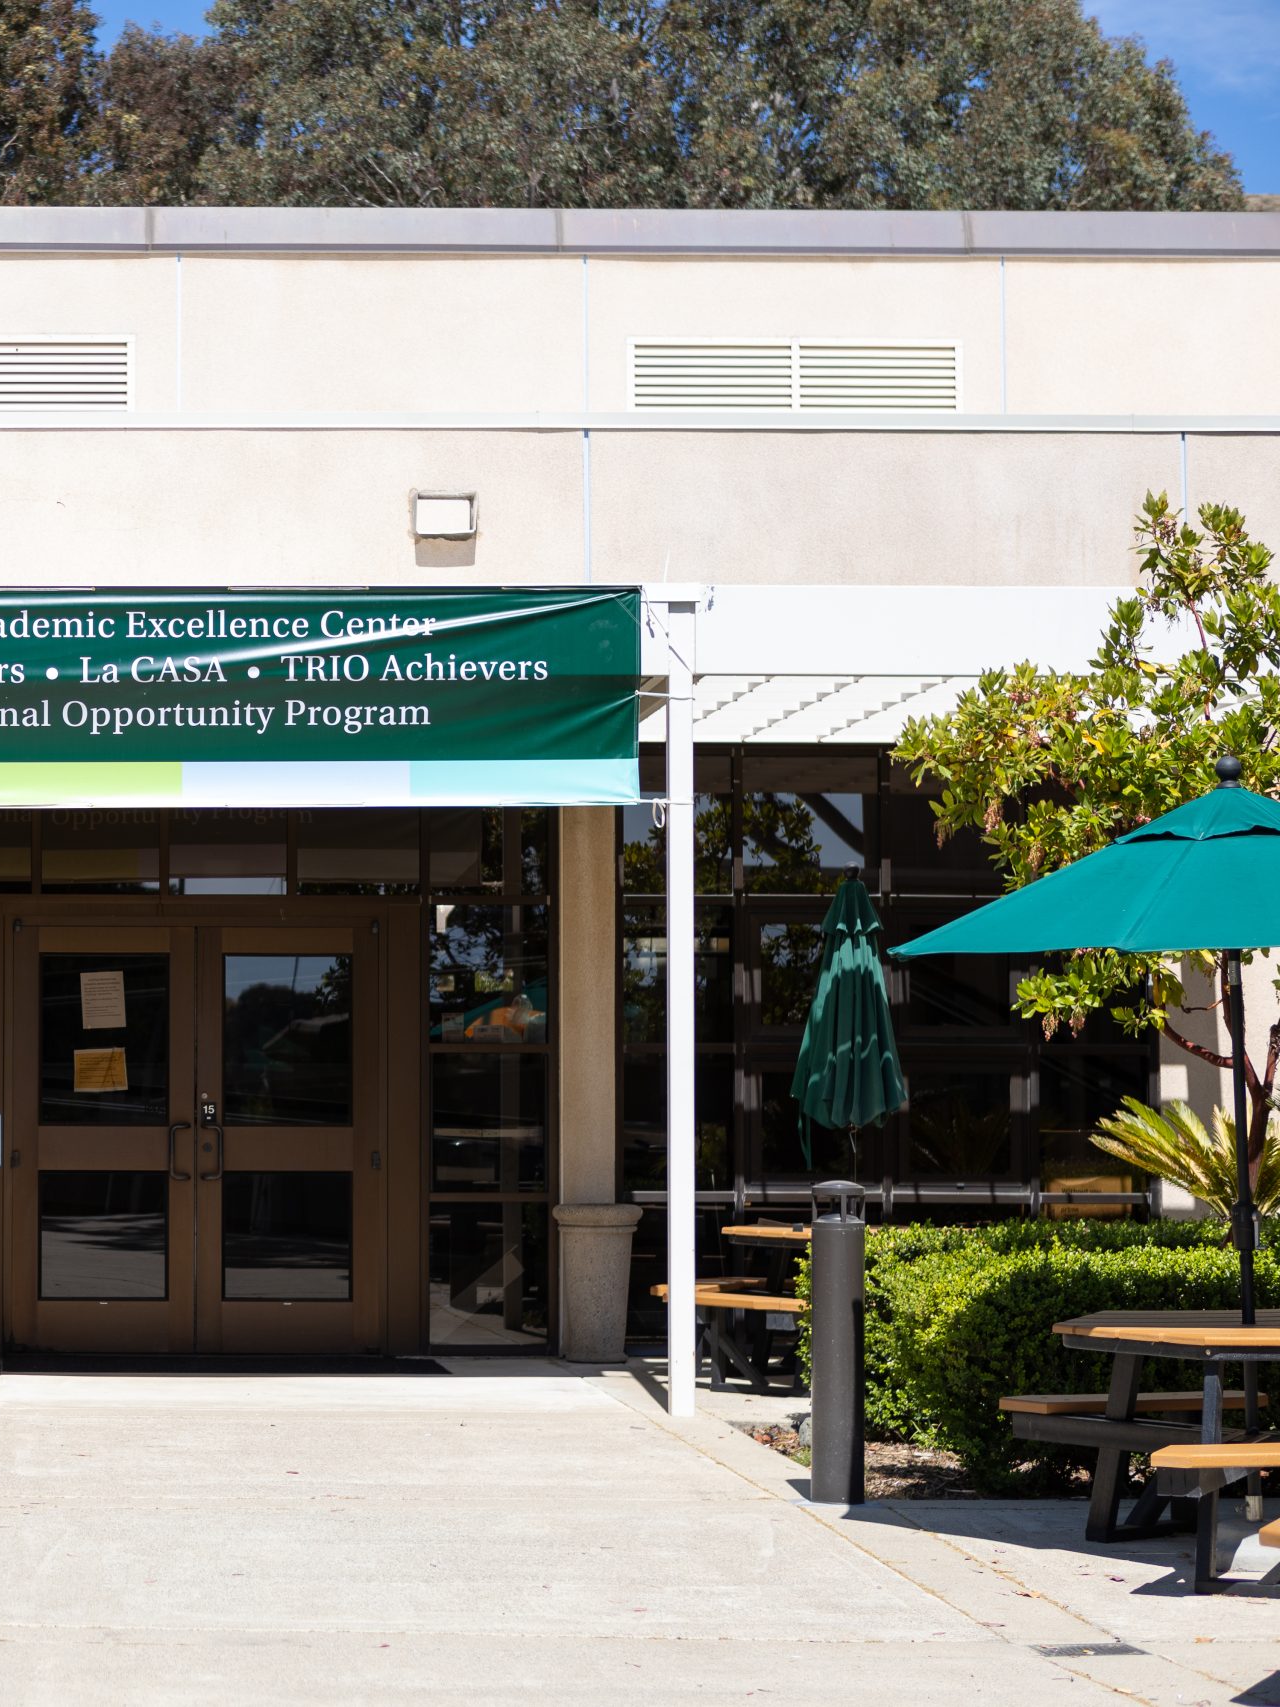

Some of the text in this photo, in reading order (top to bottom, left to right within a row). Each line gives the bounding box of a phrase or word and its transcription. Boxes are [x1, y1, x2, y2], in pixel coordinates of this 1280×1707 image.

[126, 610, 309, 638] Excellence
[320, 610, 436, 638] Center
[80, 657, 120, 683] La
[131, 655, 228, 684] CASA
[281, 655, 369, 682] TRIO
[379, 653, 548, 681] Achievers
[62, 699, 275, 735] Opportunity
[285, 699, 431, 734] Program
[203, 1105, 215, 1114] 15
